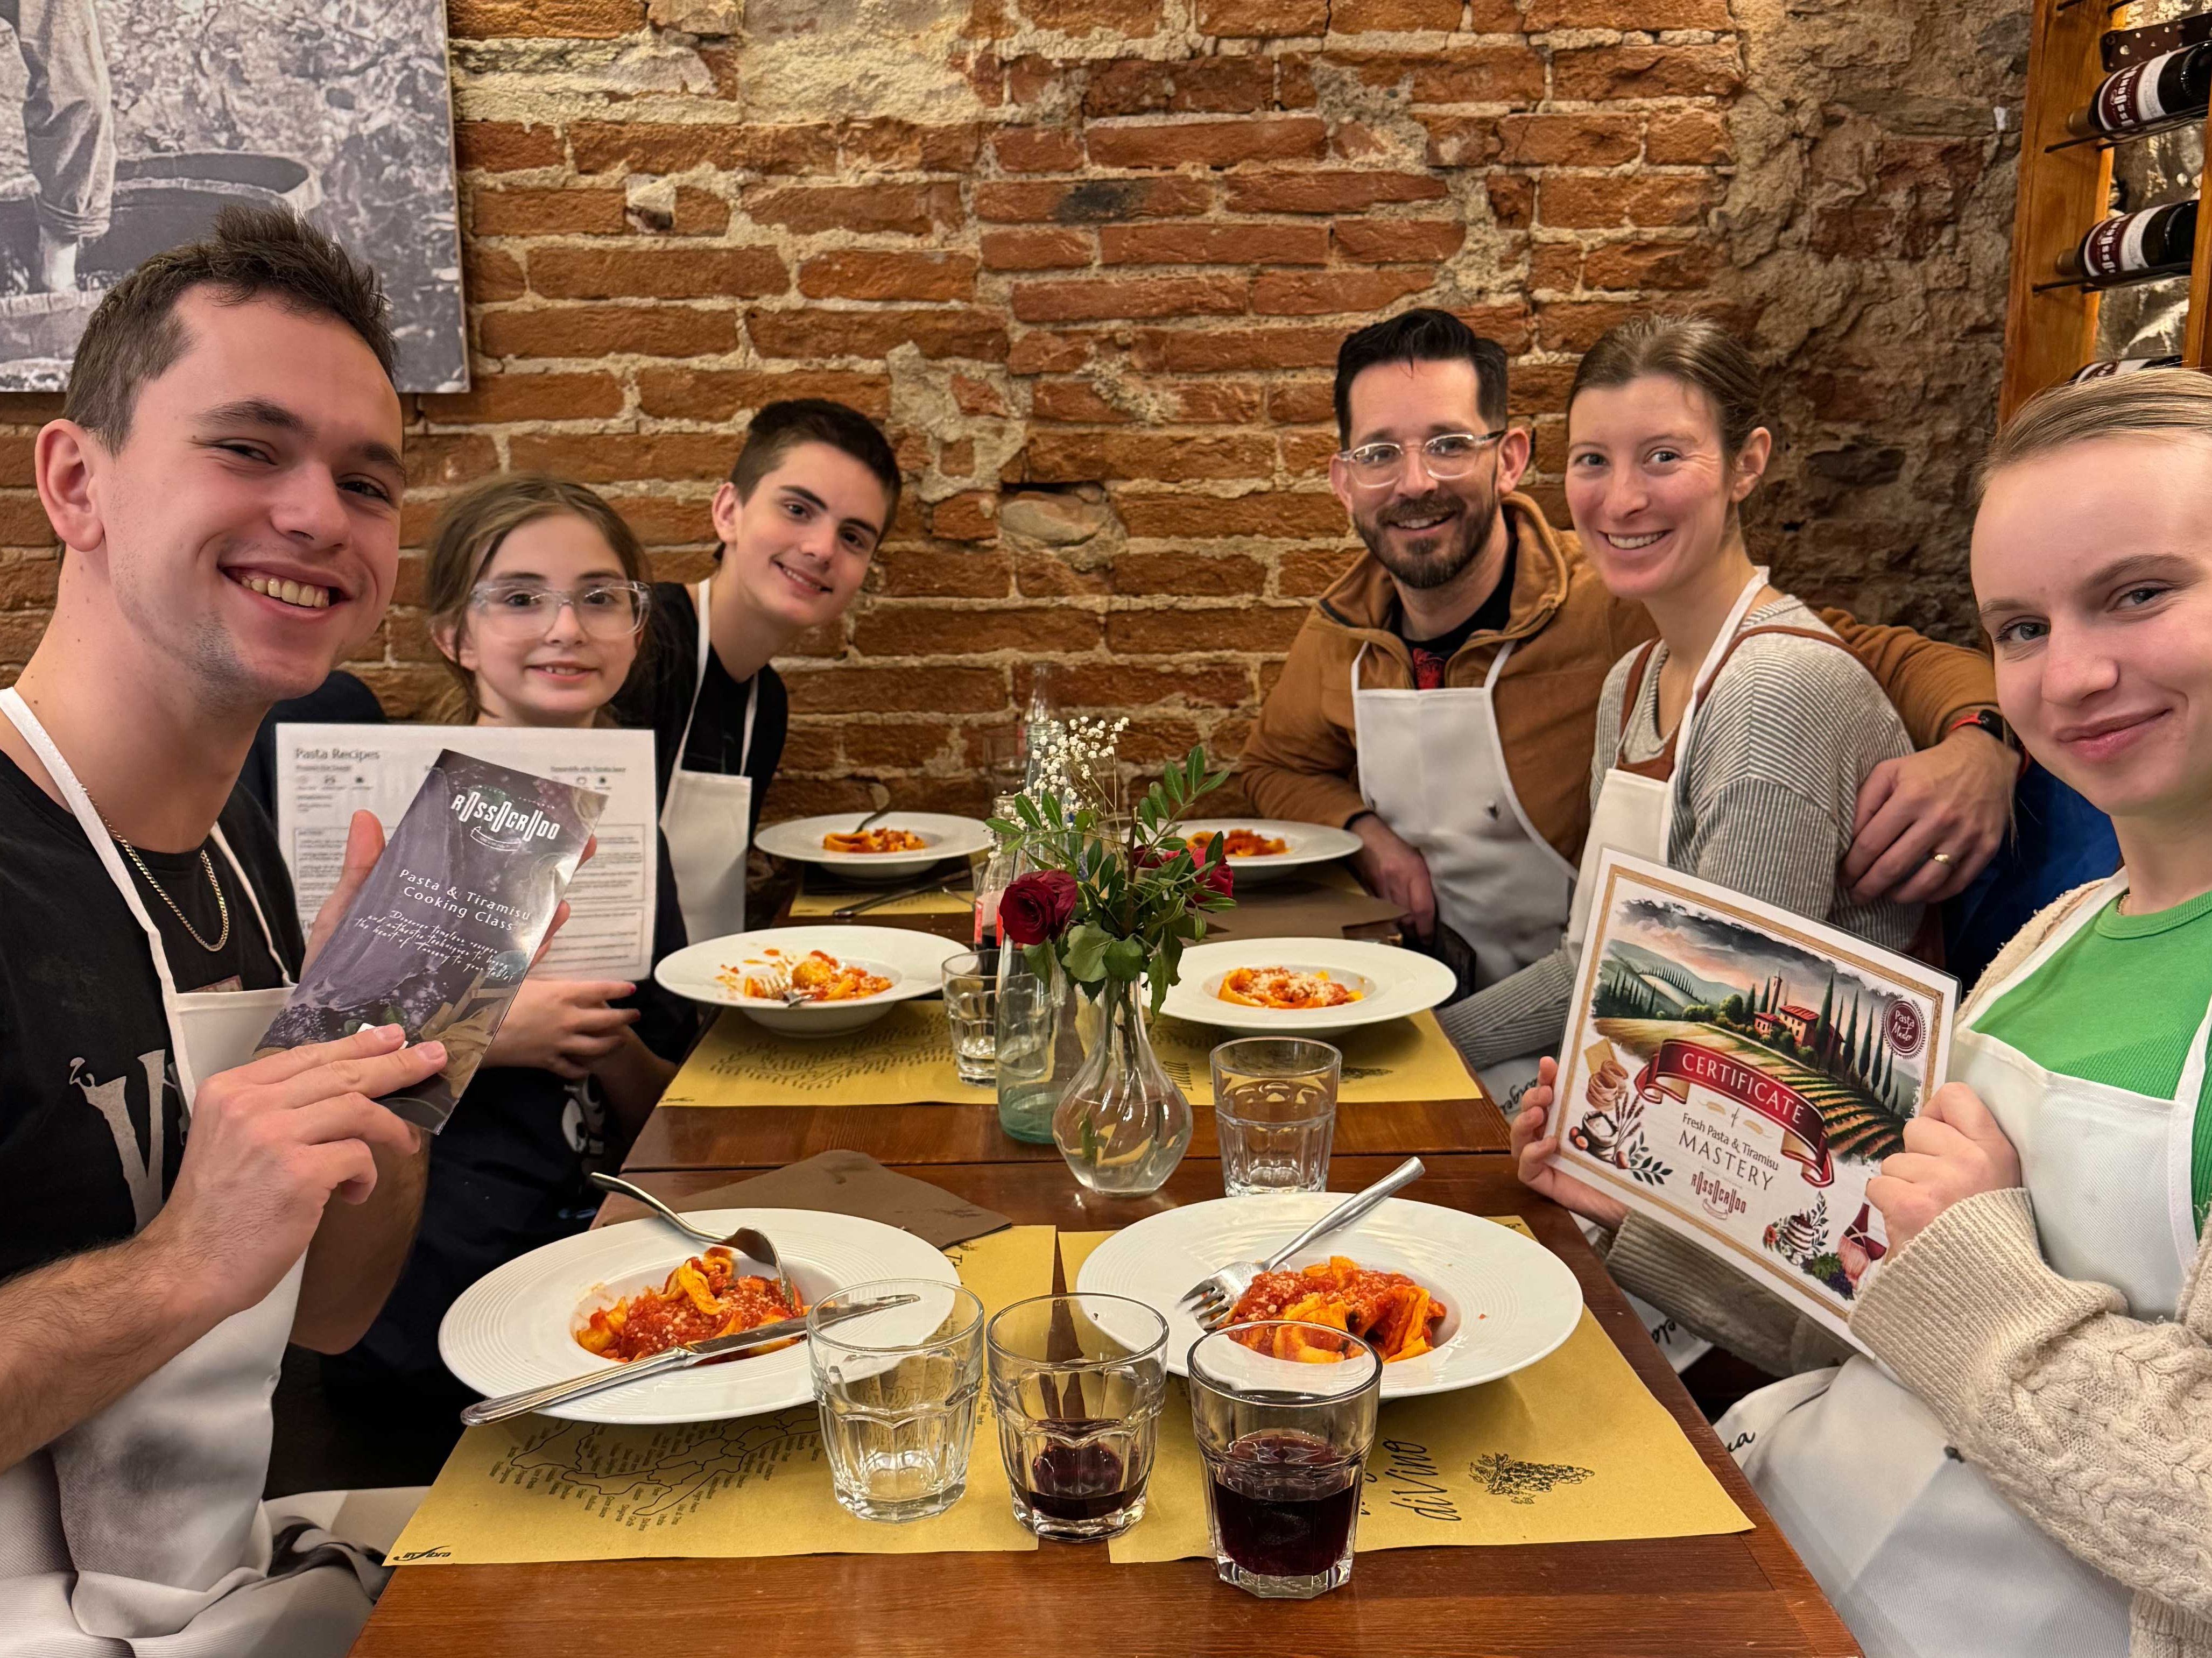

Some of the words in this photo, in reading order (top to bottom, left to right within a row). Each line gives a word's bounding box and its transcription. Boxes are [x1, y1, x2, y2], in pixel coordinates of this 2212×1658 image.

[295, 748, 328, 760] Pasta
[332, 748, 380, 763] Recipes
[399, 869, 440, 891] Pasta
[447, 886, 458, 900] &
[466, 891, 531, 920] Tiramisu
[404, 886, 468, 918] Cooking
[475, 912, 513, 930] Class
[1895, 1010, 1914, 1028] Pasta
[1682, 1053, 1805, 1124] CERTIFICATE
[1679, 1130, 1774, 1191] MASTERY
[1682, 1112, 1706, 1133] Fresh
[1707, 1125, 1729, 1145] Pasta
[1731, 1139, 1741, 1153] &
[1742, 1142, 1779, 1171] Tiramisu
